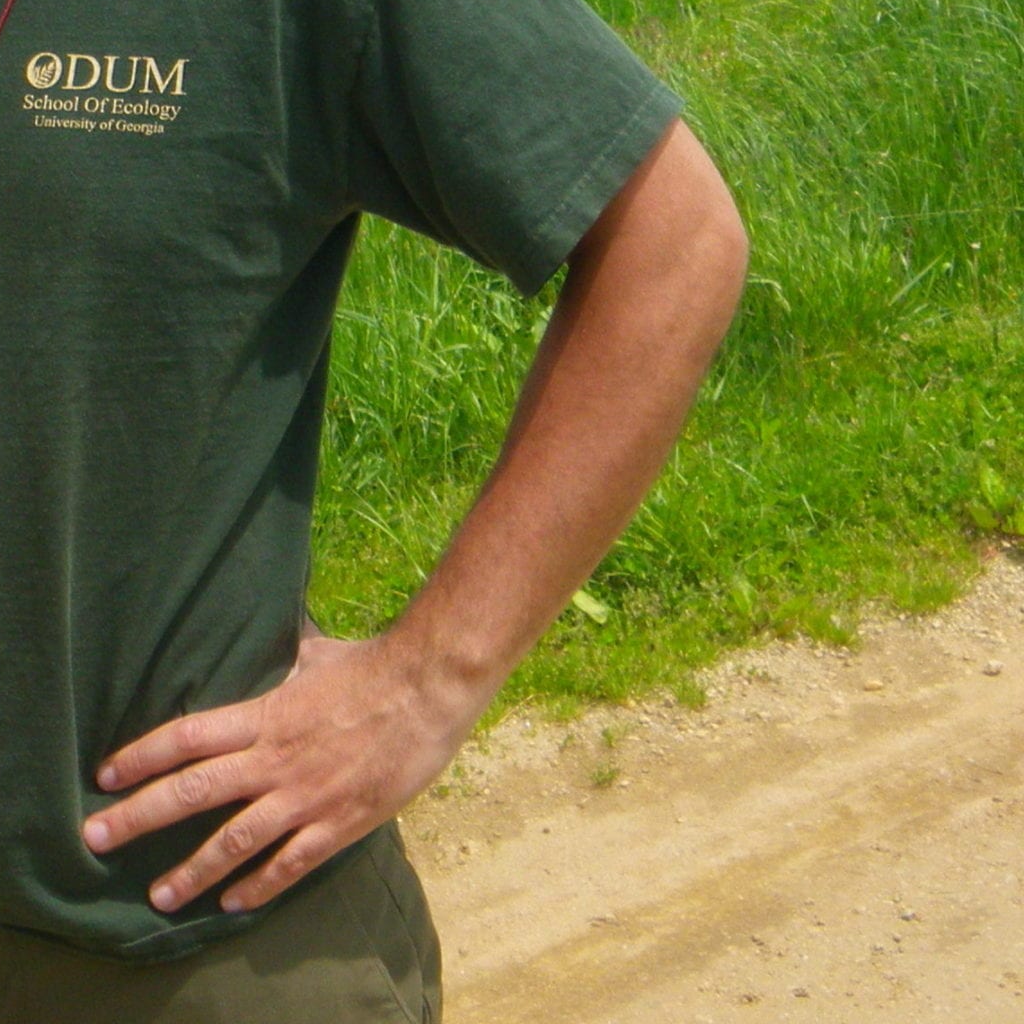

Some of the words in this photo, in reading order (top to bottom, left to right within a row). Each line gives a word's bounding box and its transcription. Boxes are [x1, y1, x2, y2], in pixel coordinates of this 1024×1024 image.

[26, 52, 190, 96] ODUM
[23, 94, 79, 112] School
[84, 97, 110, 114] Of
[112, 98, 181, 121] Ecology
[34, 115, 97, 132] University
[99, 119, 116, 131] of
[116, 120, 165, 136] Georgia
